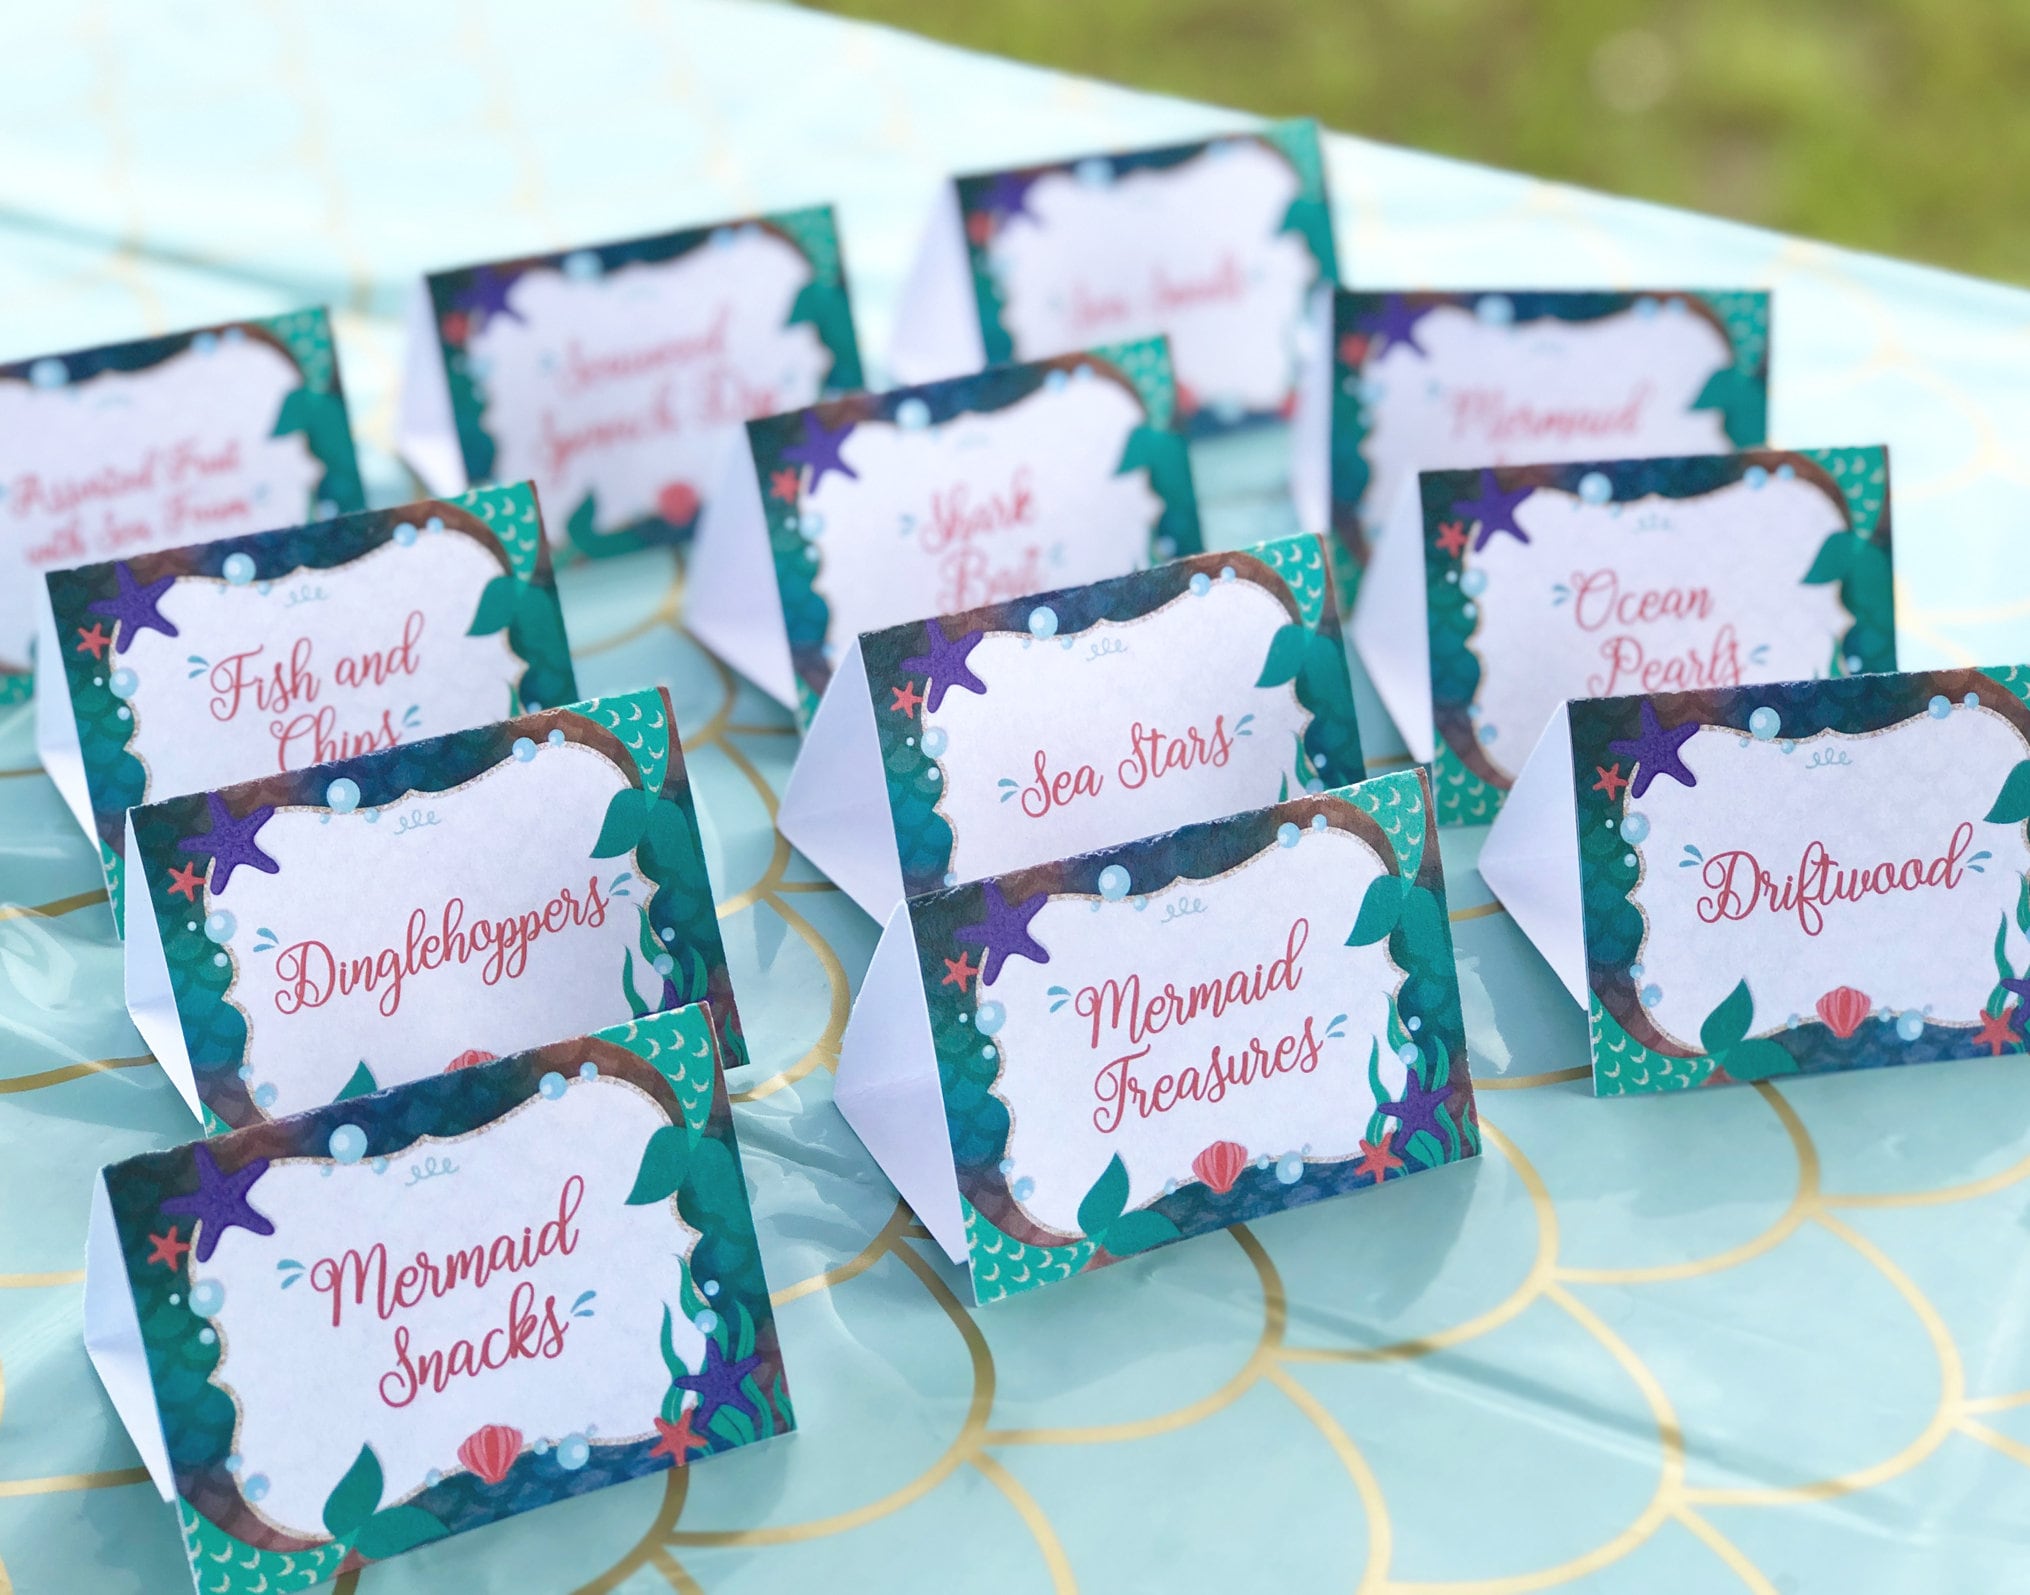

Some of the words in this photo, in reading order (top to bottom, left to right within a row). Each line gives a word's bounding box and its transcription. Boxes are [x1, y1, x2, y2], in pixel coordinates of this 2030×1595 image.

[918, 463, 1035, 555] Shark
[1570, 567, 1714, 632] Ocean
[209, 637, 320, 722] Fish
[334, 609, 425, 688] and
[1587, 623, 1745, 698] Pearls
[1021, 749, 1104, 818] Sea
[1117, 714, 1234, 789] Stars
[1697, 821, 1974, 936] Driftwood
[274, 875, 610, 1017] Dinglehoppers
[1074, 917, 1309, 1049] Mermaid
[1093, 1015, 1324, 1134] Treasures
[310, 1174, 584, 1328] Mermaid
[379, 1281, 570, 1408] Snacks
